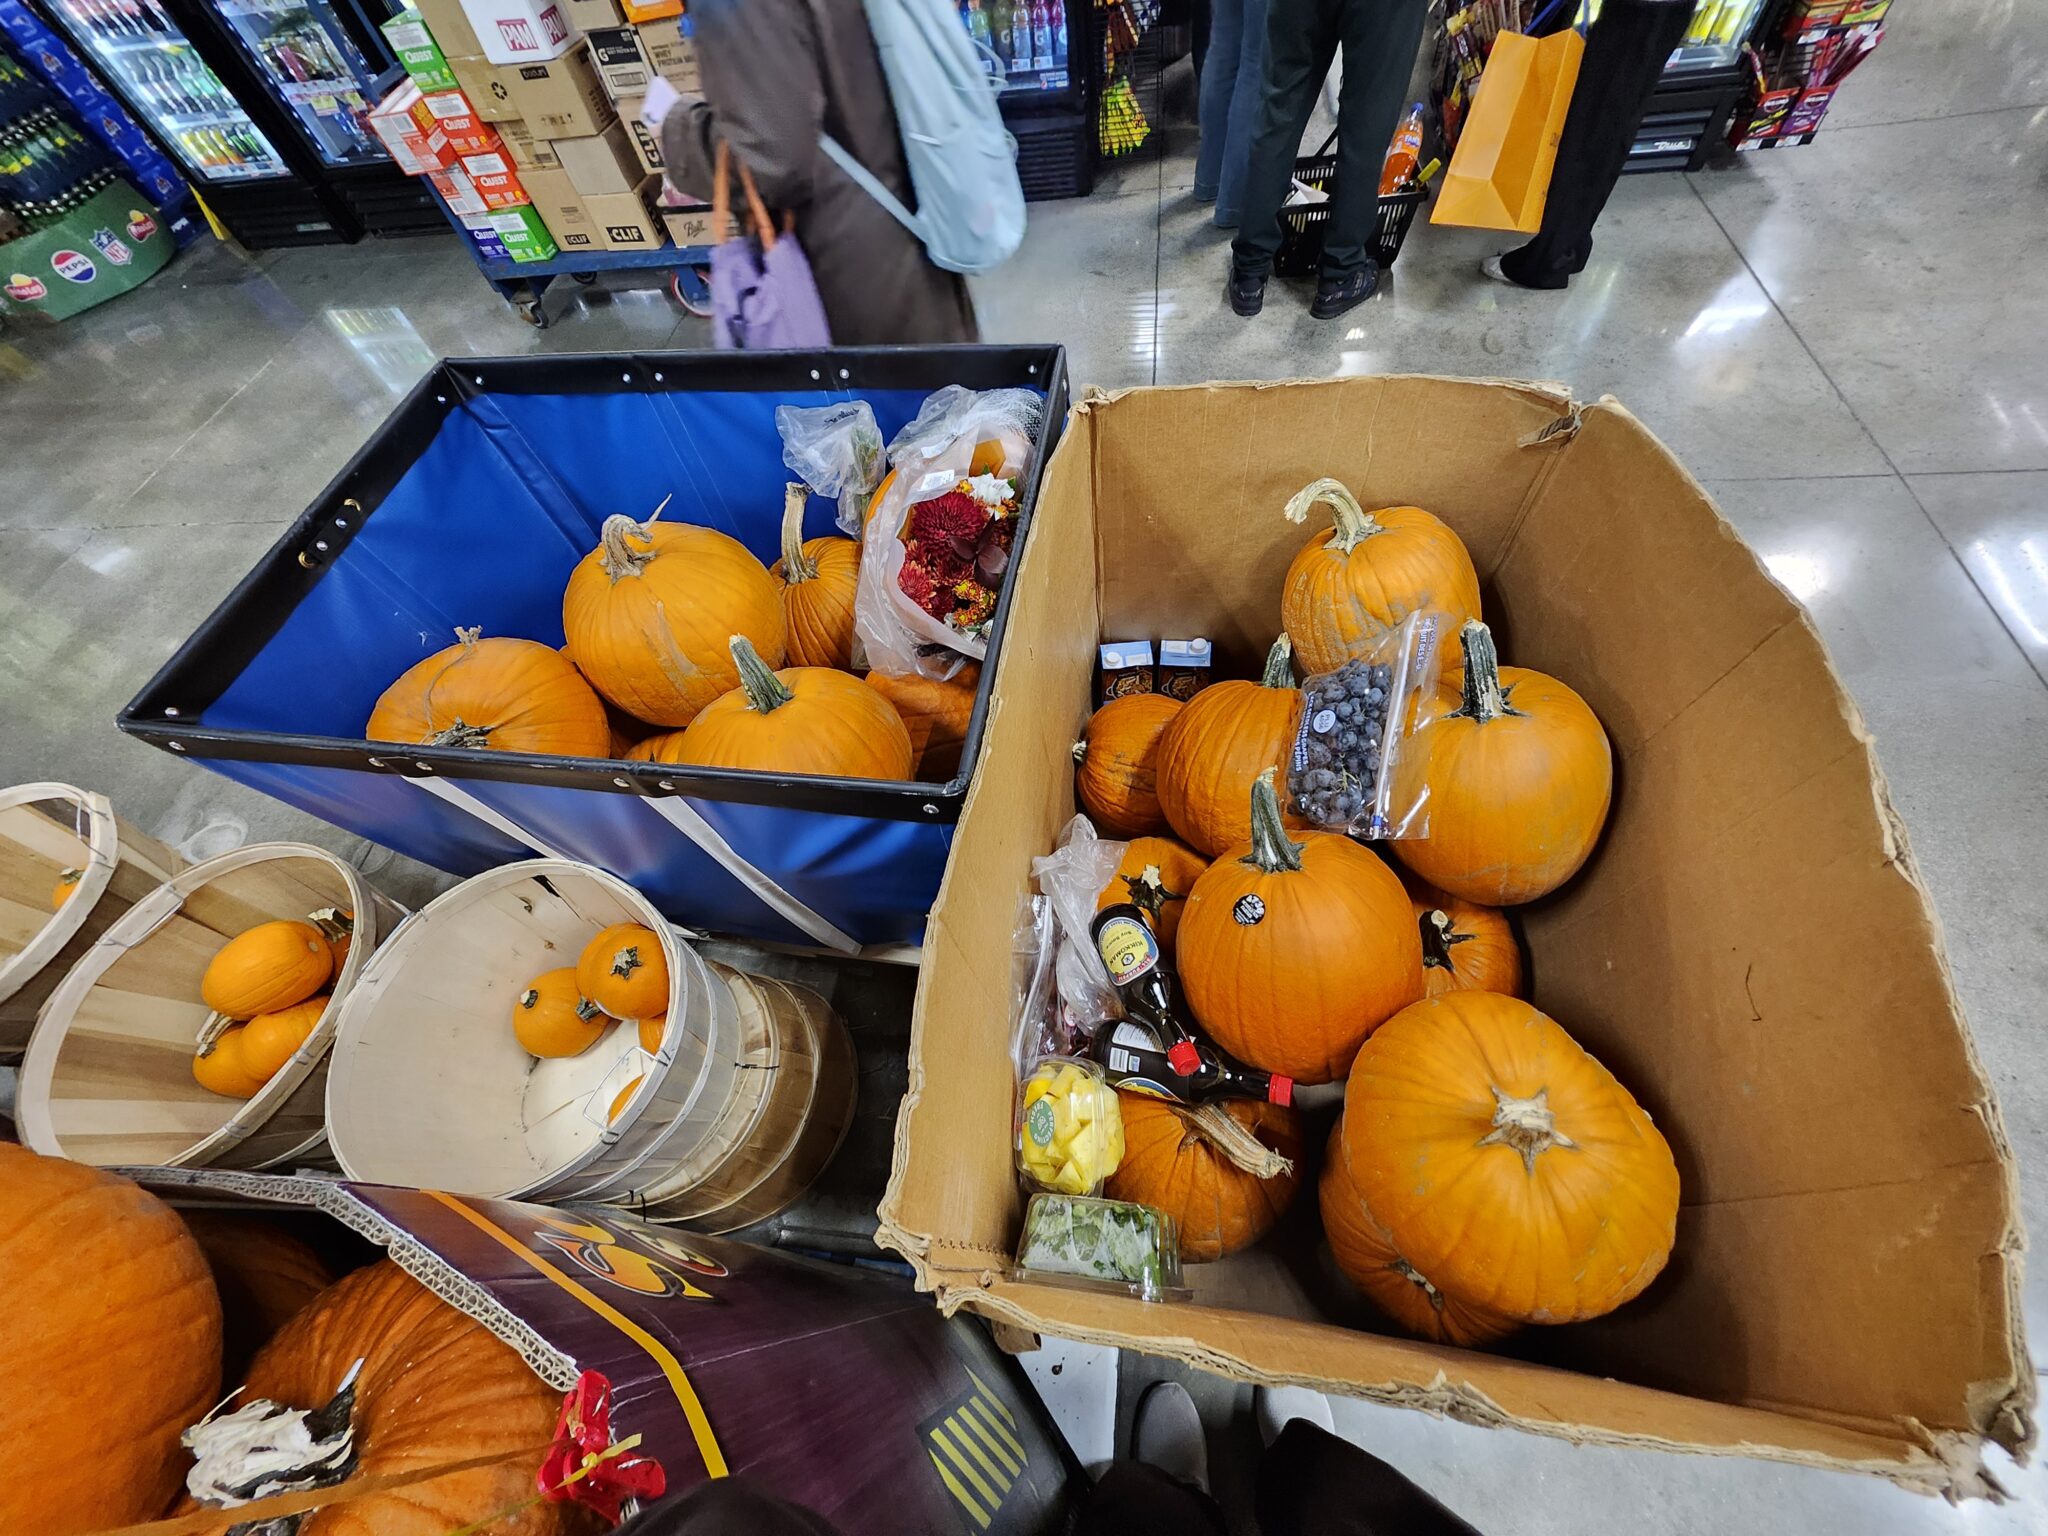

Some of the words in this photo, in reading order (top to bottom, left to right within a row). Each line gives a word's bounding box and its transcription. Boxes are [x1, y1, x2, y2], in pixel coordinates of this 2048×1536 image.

[541, 11, 567, 45] PAM
[499, 22, 539, 51] PAM
[405, 50, 434, 64] QUEST
[443, 118, 471, 131] QUEST
[480, 175, 507, 187] QUEST
[474, 230, 498, 240] QUEST
[504, 233, 529, 243] QUEST
[612, 228, 640, 240] CLIF
[60, 257, 90, 275] PEPSI
[1303, 706, 1312, 737] SEEDLESS
[1109, 939, 1143, 964] KIKKOMAN
